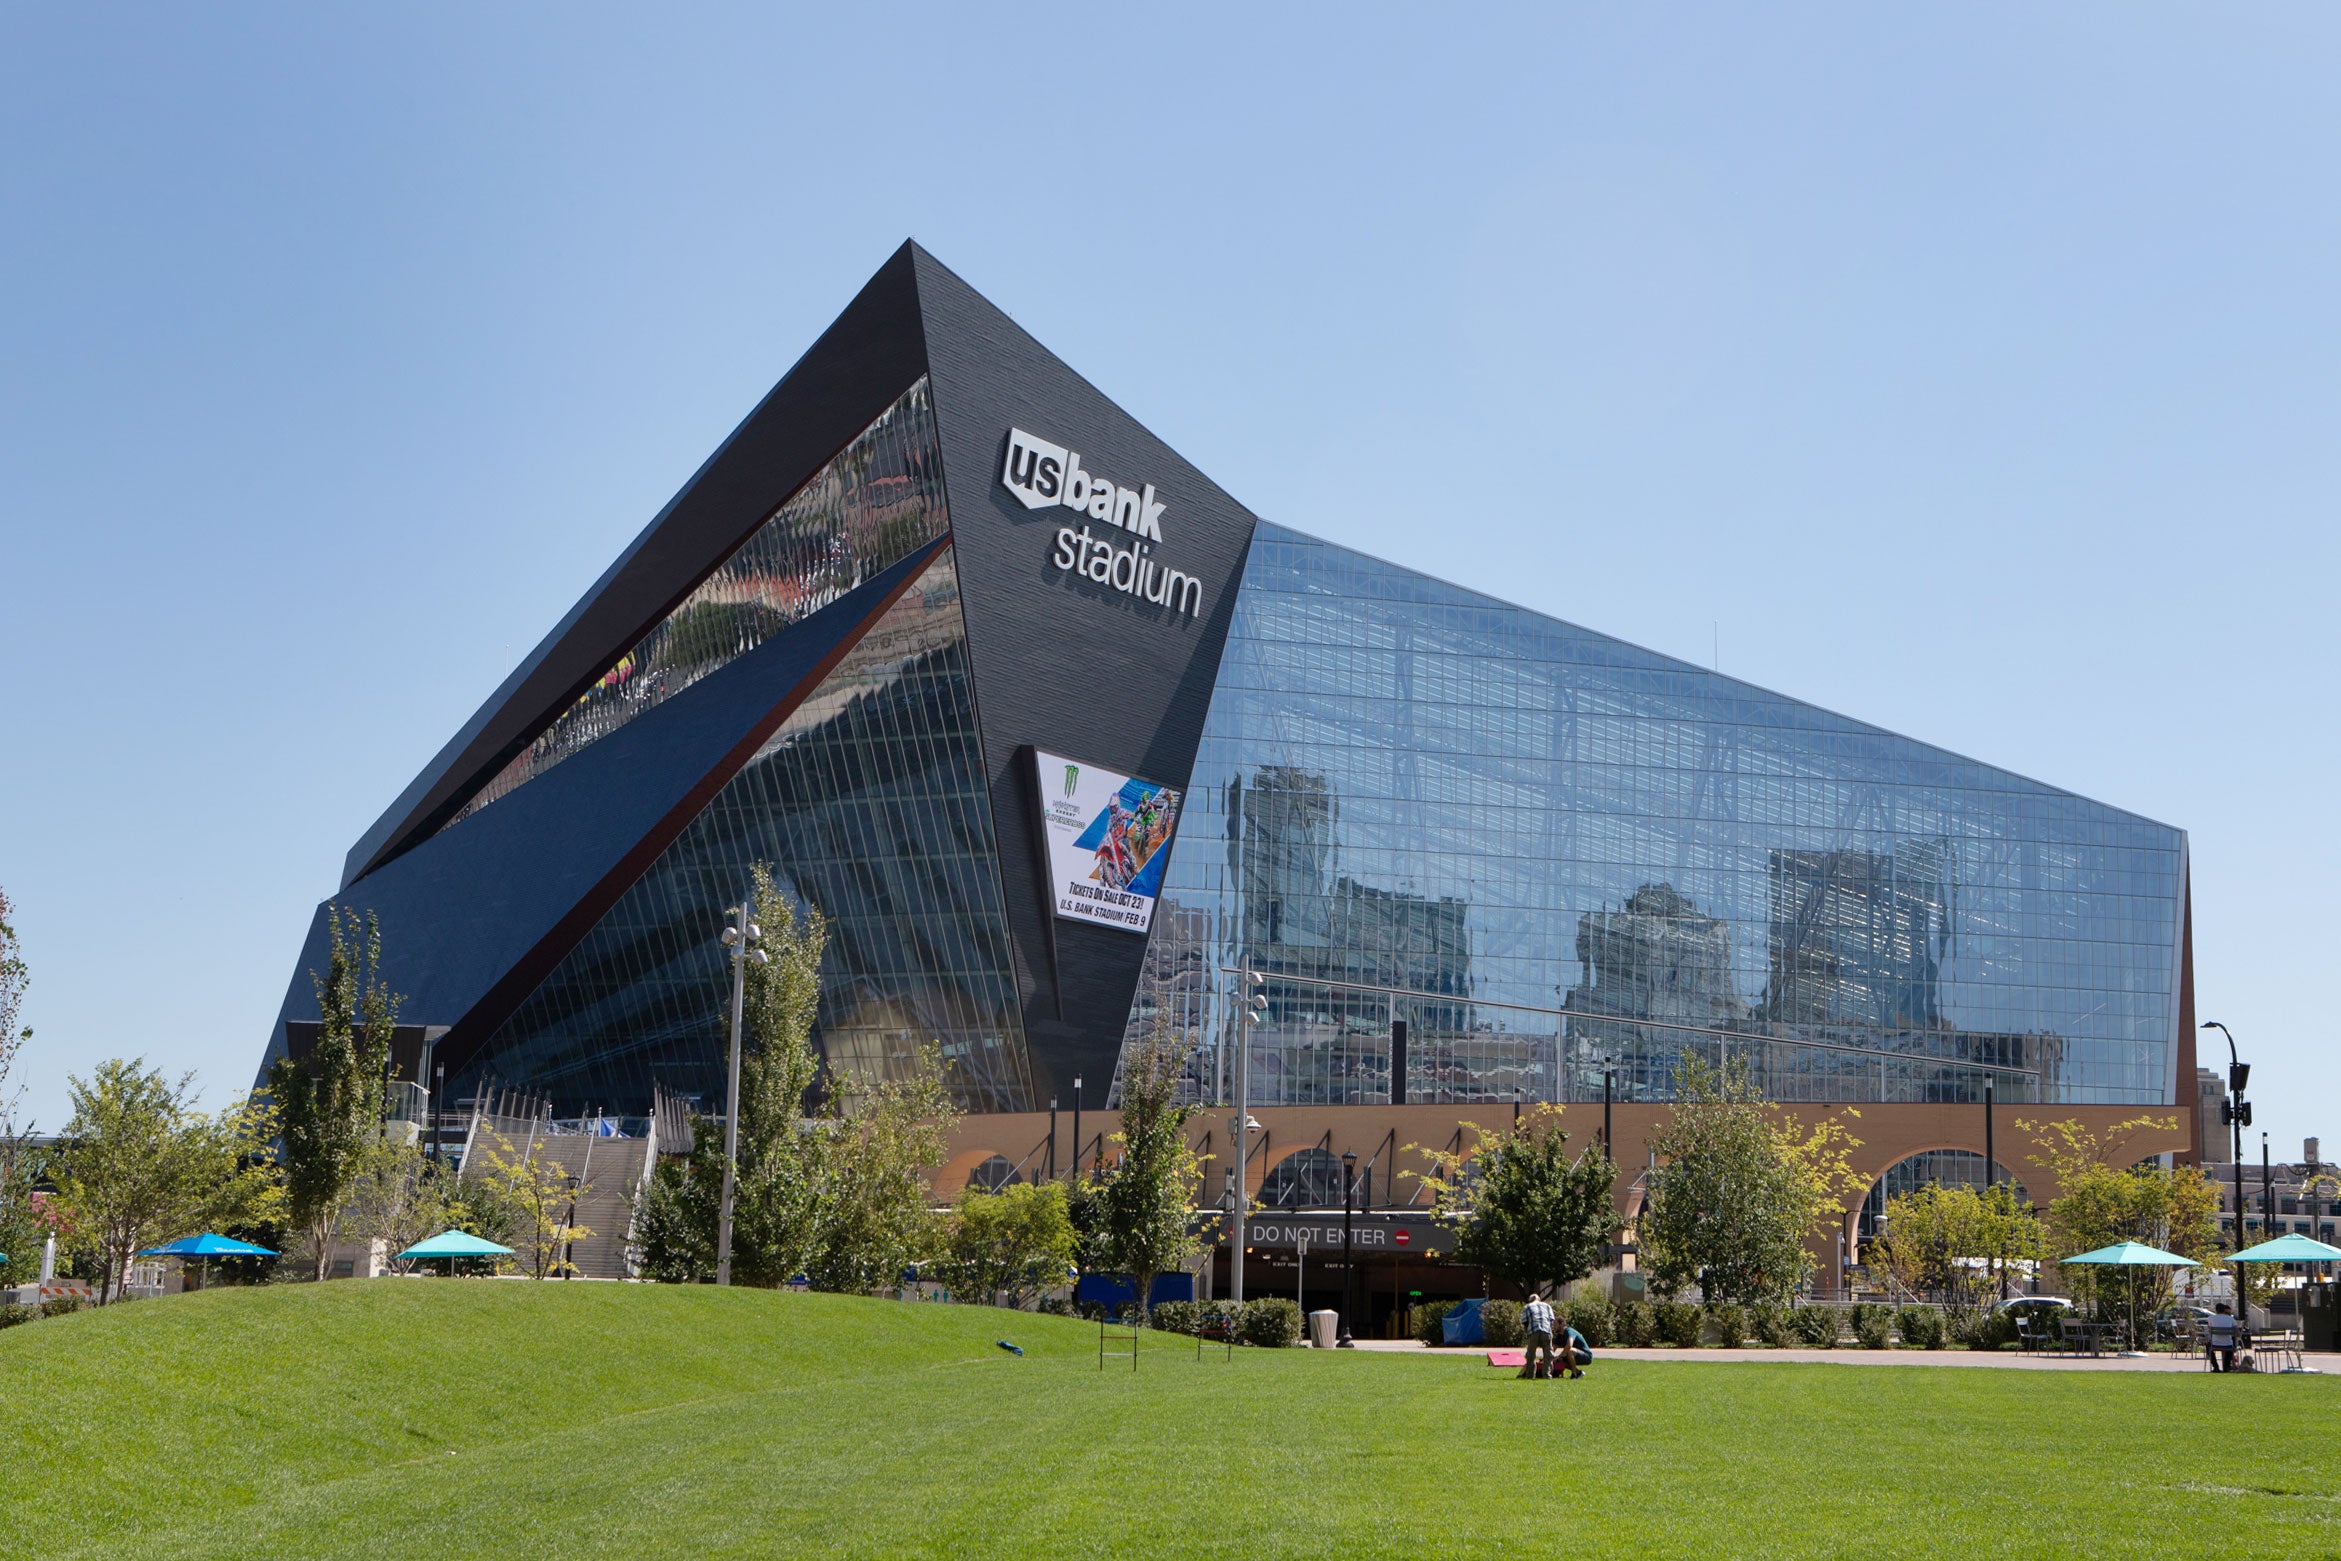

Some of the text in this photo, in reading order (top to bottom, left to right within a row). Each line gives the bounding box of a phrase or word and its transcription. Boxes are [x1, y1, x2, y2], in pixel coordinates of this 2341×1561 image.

[1053, 525, 1202, 618] stadium
[1068, 881, 1094, 899] TICKETS
[1118, 893, 1131, 907] OCT
[1131, 896, 1145, 911] 23!
[1060, 898, 1146, 927] U.S. BANK STADIUM FEB 9
[1253, 1226, 1385, 1245] DO NOT ENTER
